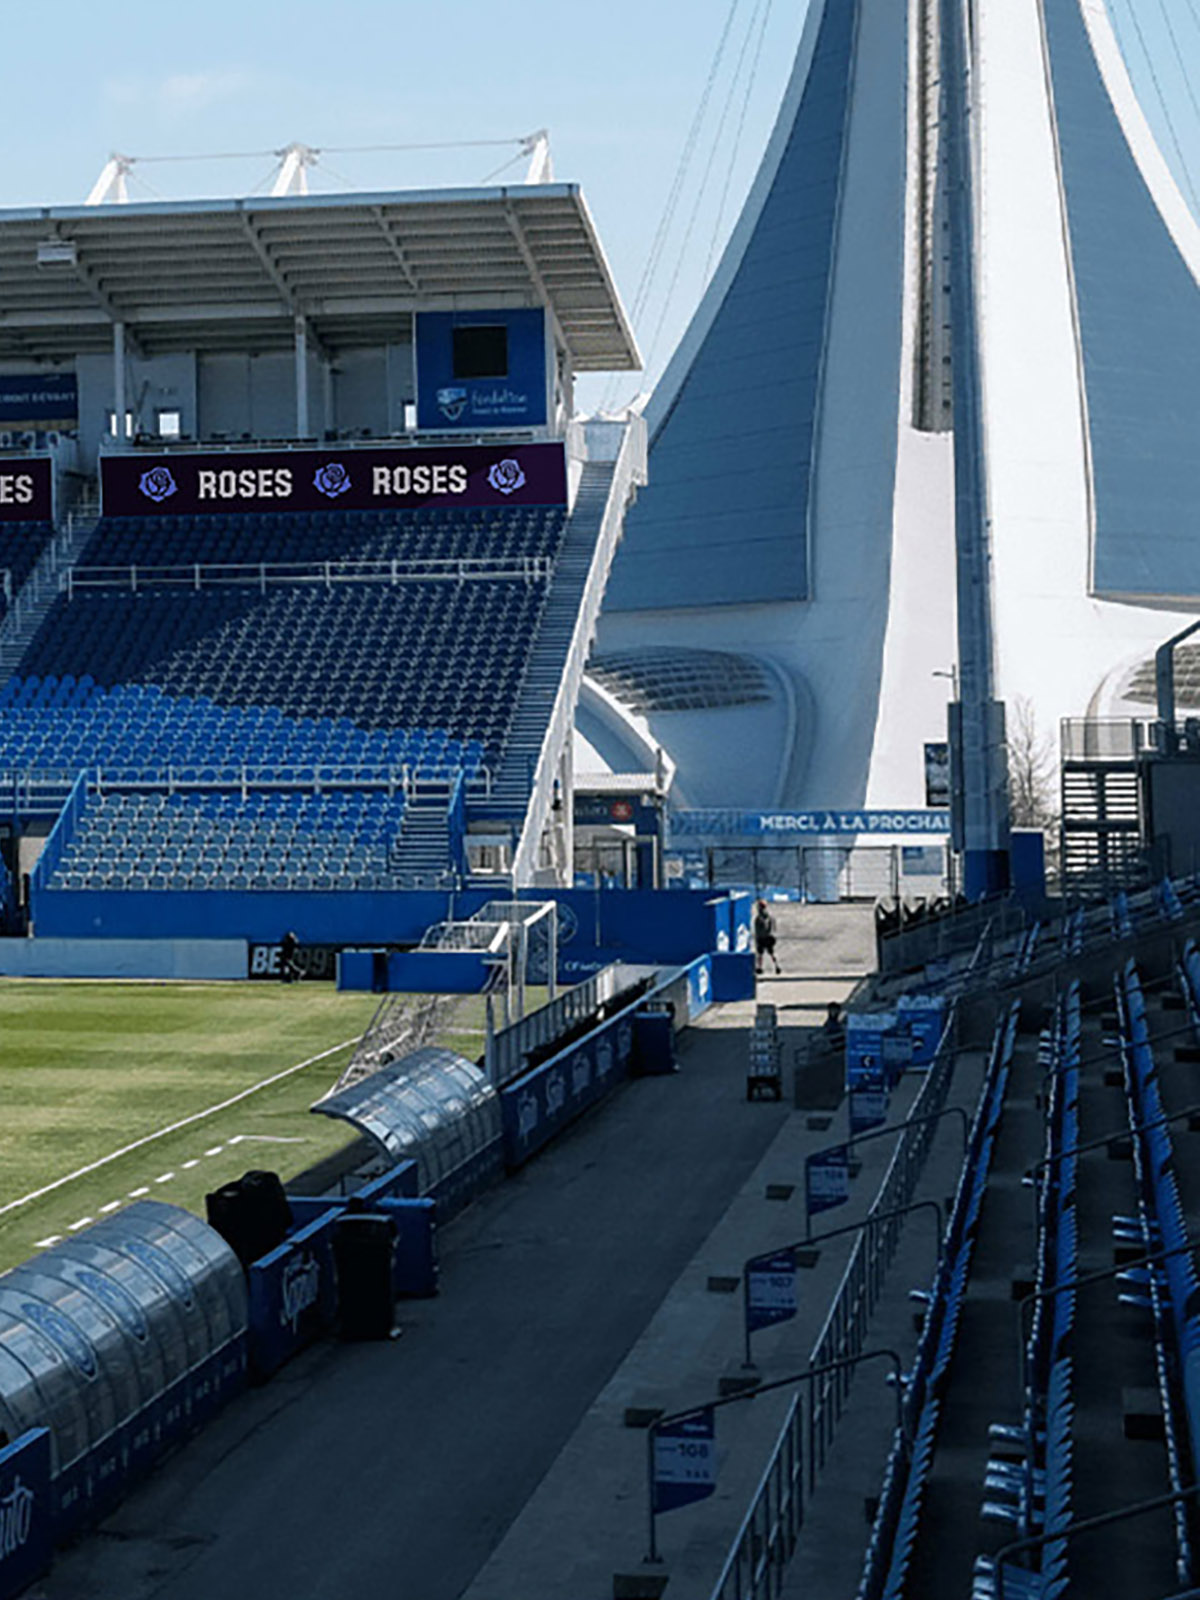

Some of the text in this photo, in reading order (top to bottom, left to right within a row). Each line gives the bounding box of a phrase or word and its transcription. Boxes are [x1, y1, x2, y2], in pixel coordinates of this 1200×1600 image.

[199, 465, 467, 498] ROSES ROSES
[840, 815, 865, 829] LA
